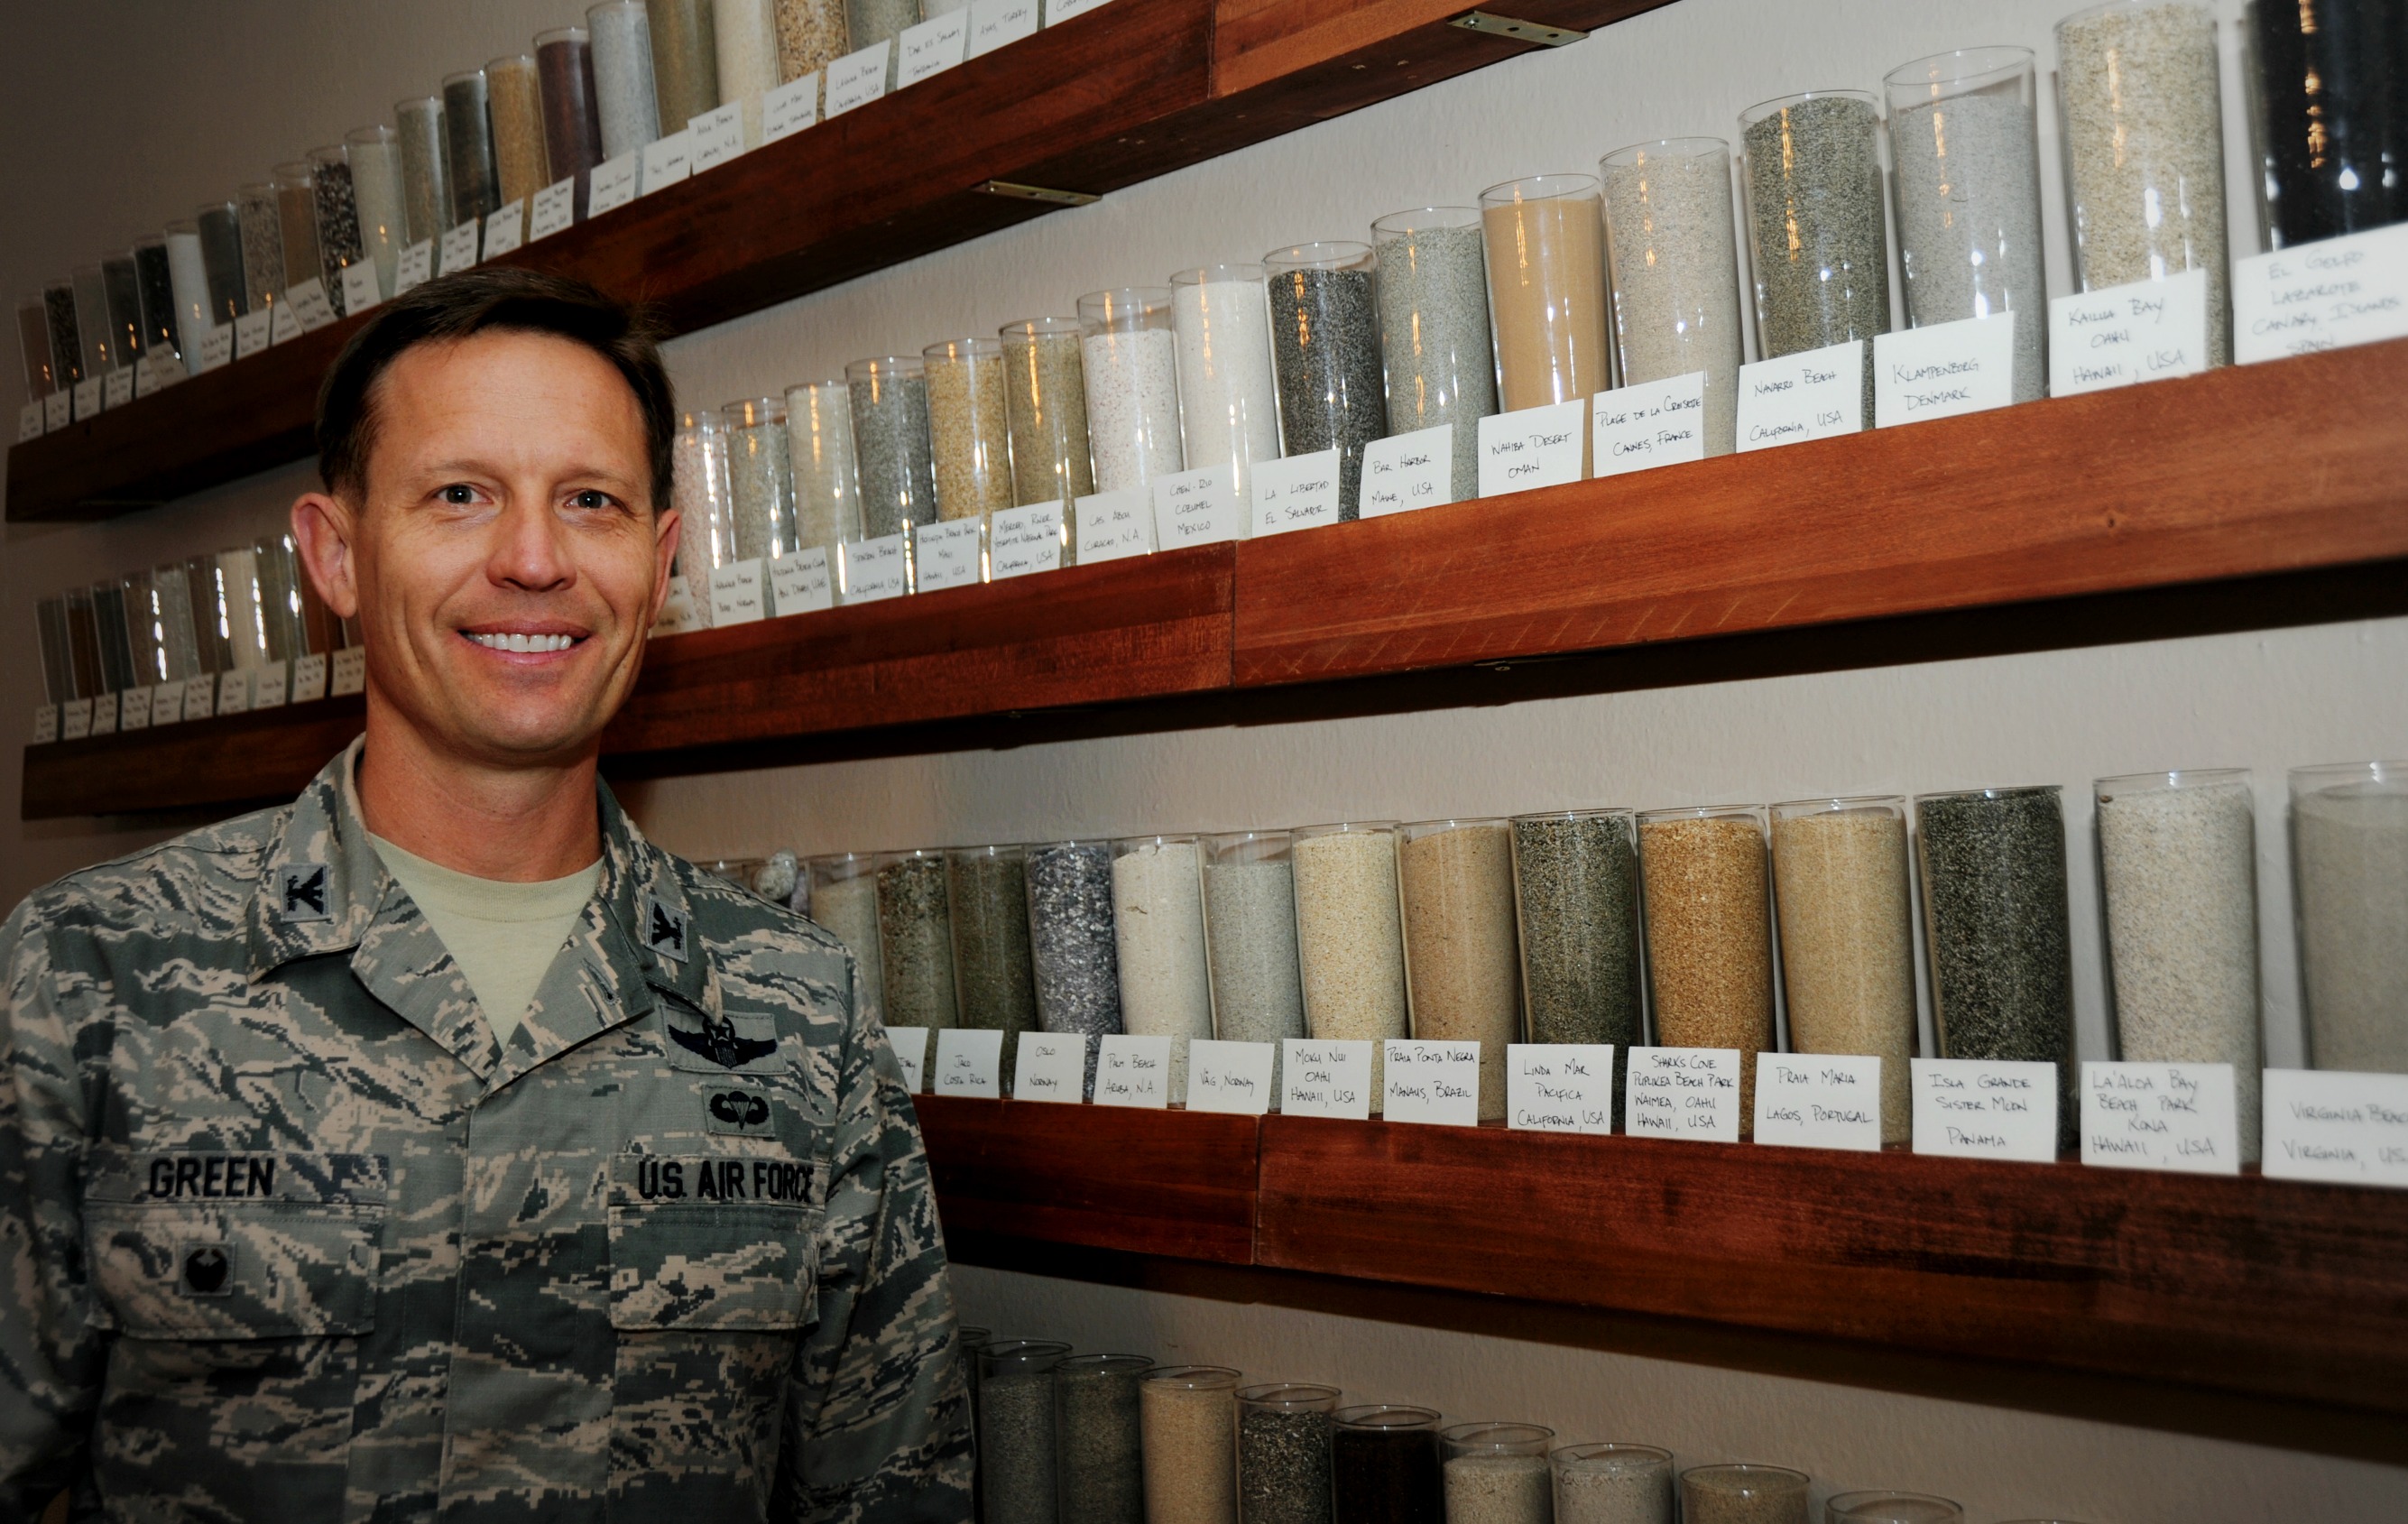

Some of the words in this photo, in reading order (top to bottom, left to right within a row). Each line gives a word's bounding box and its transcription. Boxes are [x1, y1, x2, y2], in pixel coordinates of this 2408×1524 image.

[2268, 262, 2293, 280] EL
[2069, 308, 2116, 327] KAILUA
[2127, 297, 2164, 325] BAY
[2090, 328, 2131, 349] OAHU
[2146, 348, 2186, 371] USA
[1893, 357, 1979, 383] KLAMPENBORG
[1754, 380, 1794, 397] NAVARRO
[1802, 368, 1837, 385] BEACH
[1904, 386, 1970, 411] DENMARK
[1596, 411, 1627, 427] PLAGE
[1634, 411, 1646, 420] DE
[1650, 408, 1660, 417] LA
[1749, 419, 1810, 441] CALIFORNIA,
[1817, 410, 1843, 427] USA
[1491, 439, 1525, 456] WAHIBA
[1529, 431, 1573, 448] DESERT
[1613, 439, 1652, 457] CANNES,
[1656, 429, 1693, 446] FRANCE
[1373, 460, 1393, 475] BAR
[1400, 454, 1431, 469] HARBOR
[1508, 457, 1540, 478] OMAN
[1265, 488, 1277, 501] LA
[1290, 480, 1330, 494] LIBERTAD
[1412, 482, 1434, 496] USA
[1175, 500, 1213, 515] COZUMEL
[1265, 512, 1277, 525] EL
[1285, 503, 1328, 520] SALVADOR
[1031, 513, 1053, 524] RIVER
[1177, 521, 1211, 536] MEXICO
[1036, 549, 1056, 564] USA
[953, 566, 966, 577] USA
[887, 577, 900, 589] USA
[1036, 1047, 1056, 1058] OSLO
[1107, 1053, 1125, 1069] PALM
[1131, 1054, 1157, 1069] BEACH
[1296, 1048, 1322, 1065] MOKU
[1329, 1047, 1346, 1063] NUI
[1415, 1047, 1443, 1064] PONTA
[1447, 1047, 1475, 1063] NEGRA
[1690, 1055, 1717, 1069] COVE
[1524, 1058, 1551, 1076] LINDA
[1564, 1058, 1590, 1076] MAR
[1776, 1067, 1810, 1085] PRAIA
[1821, 1068, 1857, 1086] MARIA
[1029, 1073, 1059, 1093] NORWAY
[1224, 1070, 1254, 1098] NORWAY
[1305, 1071, 1331, 1084] OAHU
[1632, 1071, 1672, 1087] PUPUKEA
[1675, 1071, 1703, 1087] BEACH
[1707, 1073, 1734, 1088] PARK
[1928, 1074, 1965, 1090] ISLA
[1977, 1073, 2033, 1090] GRANDE
[2167, 1069, 2200, 1098] BAY
[1104, 1078, 1132, 1101] ARUBA,
[1137, 1077, 1157, 1095] N.A.
[1291, 1086, 1328, 1109] HAWAII,
[1333, 1089, 1355, 1104] USA
[1389, 1081, 1429, 1104] MANAUS,
[1434, 1081, 1472, 1098] BRAZIL
[1535, 1082, 1583, 1102] PACIFICA
[1634, 1093, 1676, 1113] WAIMEA,
[1685, 1096, 1716, 1110] OAHU
[1934, 1095, 1986, 1111] SISTER
[1992, 1096, 2028, 1113] MOON
[2096, 1093, 2137, 1112] BEACH
[2156, 1095, 2198, 1114] PARK
[2289, 1101, 2363, 1122] VIRGINIA
[2365, 1103, 2408, 1124] BEAC
[1582, 1109, 1605, 1125] USA
[1687, 1114, 1716, 1129] USA
[1767, 1105, 1804, 1126] LAGOS,
[1811, 1104, 1875, 1124] PORTUGAL
[2127, 1113, 2169, 1133] KONA
[1946, 1126, 2007, 1148] PANAMA
[2176, 1136, 2216, 1158] USA
[2378, 1145, 2408, 1166] US
[150, 1156, 274, 1197] GREEN
[639, 1161, 687, 1199] U.S.
[697, 1160, 745, 1199] AIR
[753, 1161, 815, 1204] FORCE
